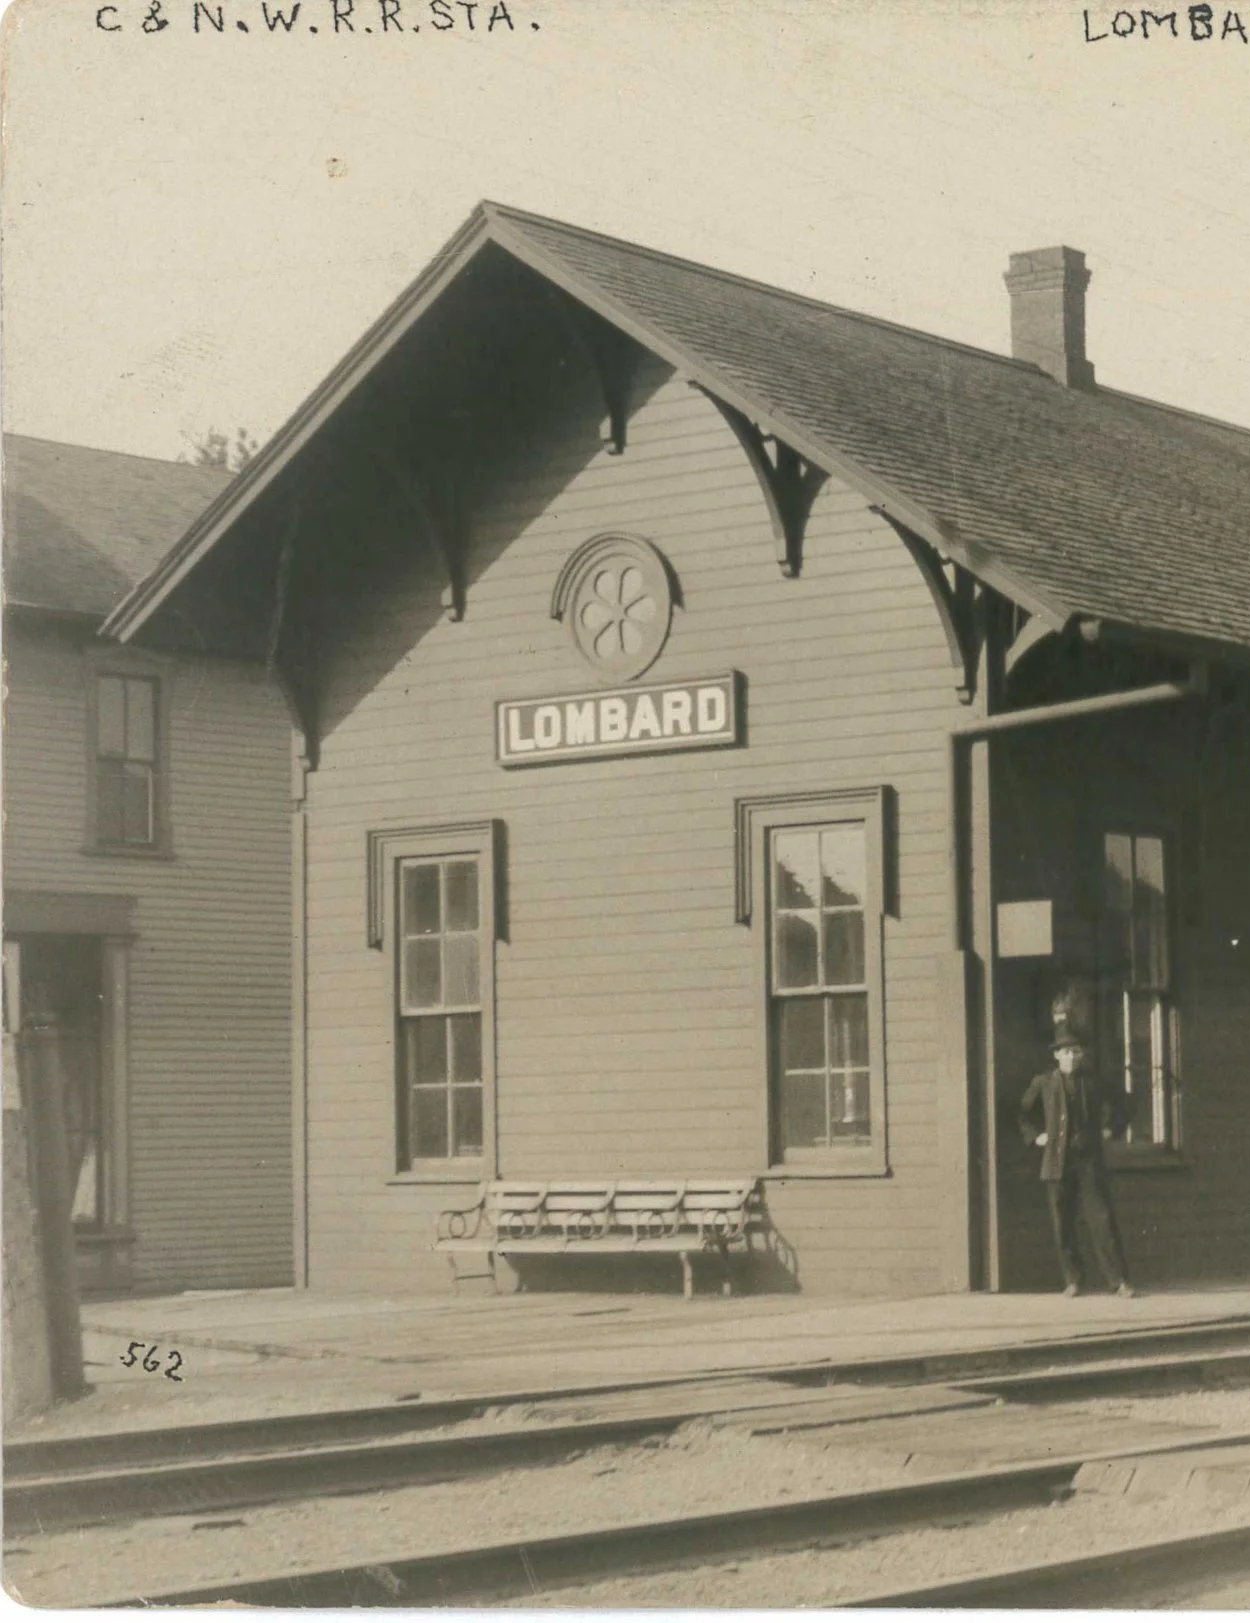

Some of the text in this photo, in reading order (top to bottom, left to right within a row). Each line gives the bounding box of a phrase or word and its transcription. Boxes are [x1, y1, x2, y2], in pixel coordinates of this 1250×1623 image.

[96, 6, 122, 32] C
[141, 0, 169, 34] &
[508, 686, 726, 751] LOMBARD
[120, 1341, 183, 1382] 562
